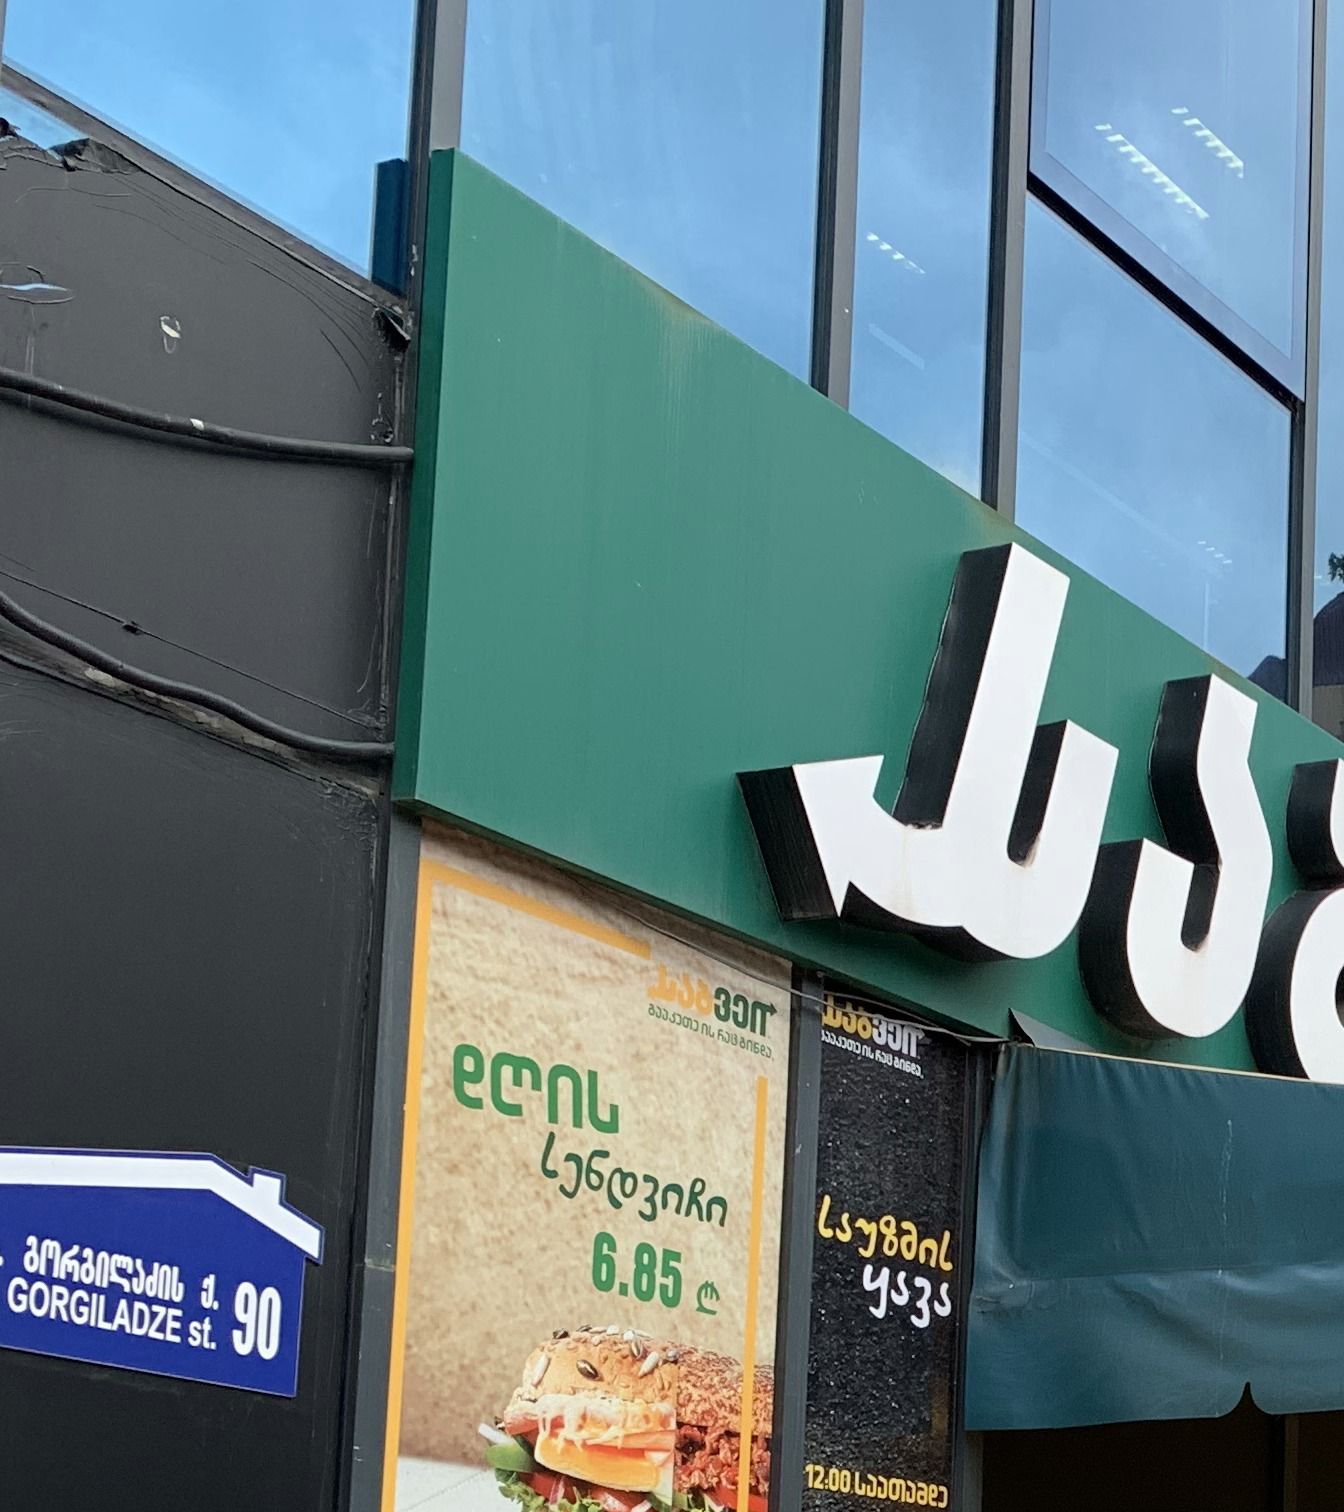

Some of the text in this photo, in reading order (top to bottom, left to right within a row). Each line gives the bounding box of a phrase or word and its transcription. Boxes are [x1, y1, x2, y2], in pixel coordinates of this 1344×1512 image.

[646, 964, 777, 1037] საბვეი
[452, 1043, 620, 1135] დღის
[540, 1131, 727, 1228] სენდვიჩი
[23, 1235, 184, 1302] გორგილაძის
[592, 1231, 682, 1310] 6.85
[817, 1194, 954, 1272] საუზმის
[7, 1277, 282, 1360] GORGILADZE st. 90
[862, 1263, 952, 1329] ყავა
[804, 1464, 949, 1509] 12:00 საათამდე
